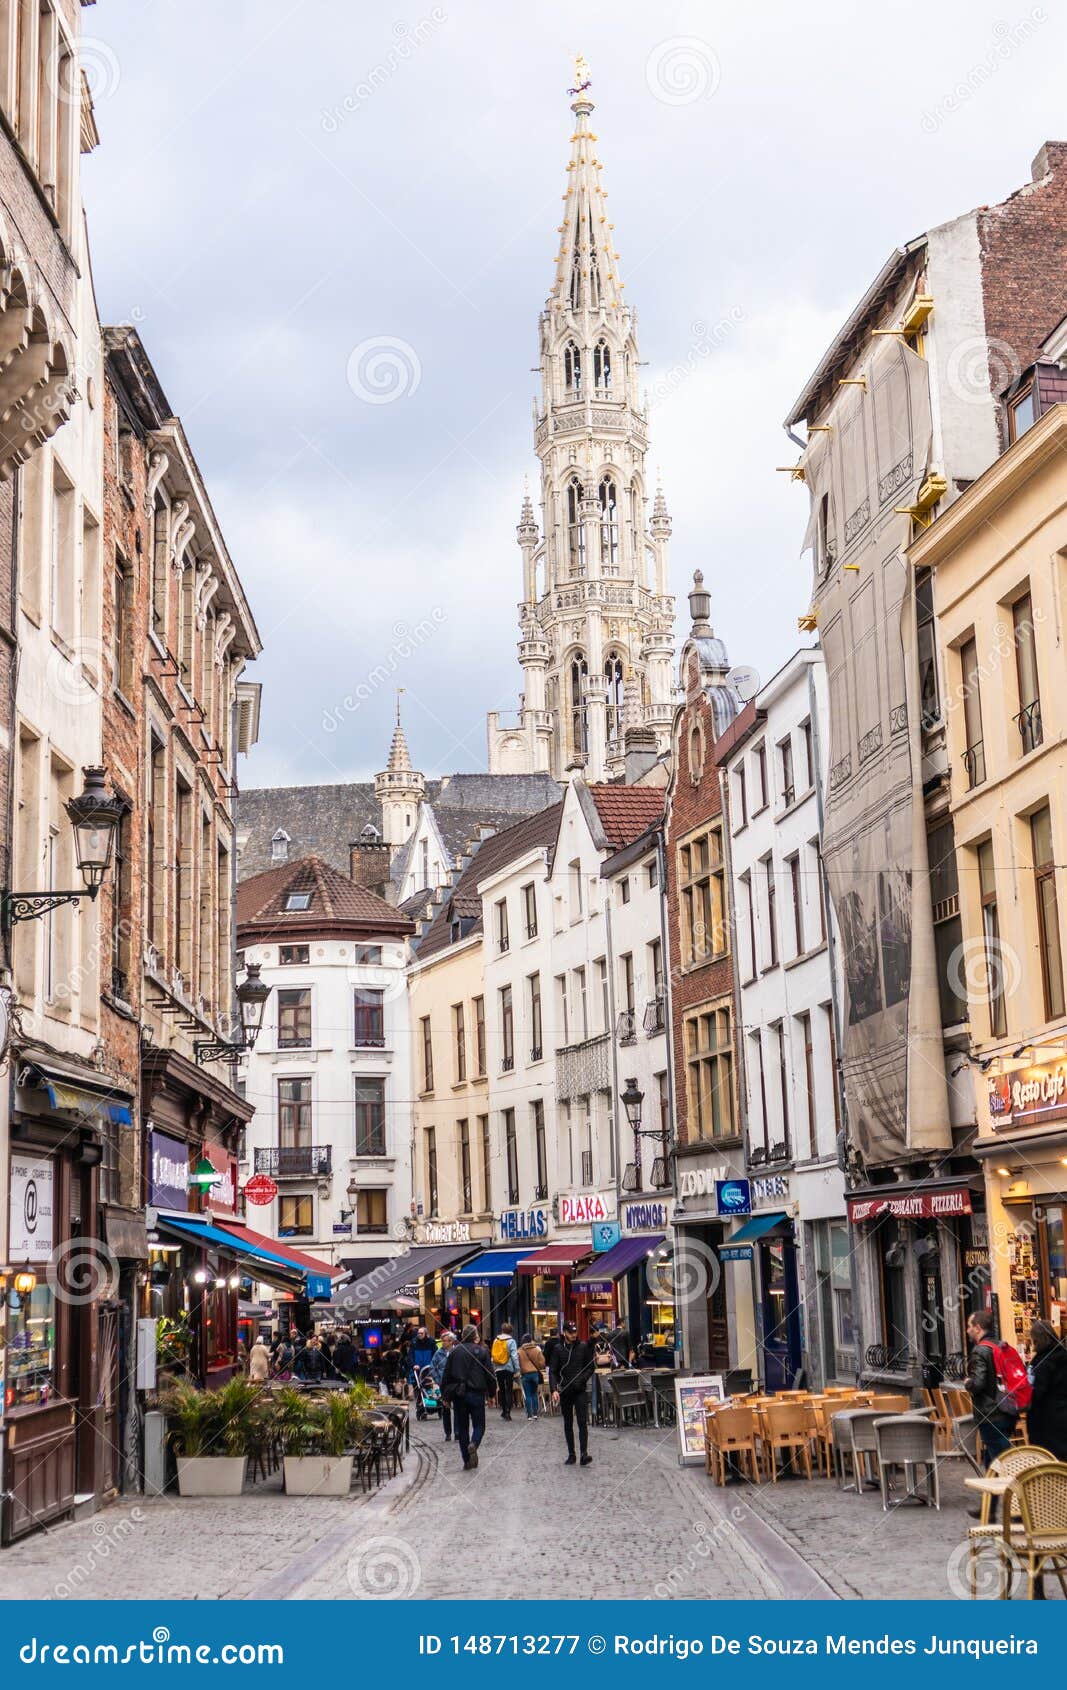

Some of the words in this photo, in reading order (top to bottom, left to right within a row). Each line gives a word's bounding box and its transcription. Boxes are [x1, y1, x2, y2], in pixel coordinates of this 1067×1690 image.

[1012, 1080, 1040, 1110] Resto
[562, 1196, 606, 1222] PLAKA
[626, 1202, 663, 1229] MYKONOS
[931, 1193, 964, 1213] PIZZERIA
[500, 1209, 547, 1239] HELLAS
